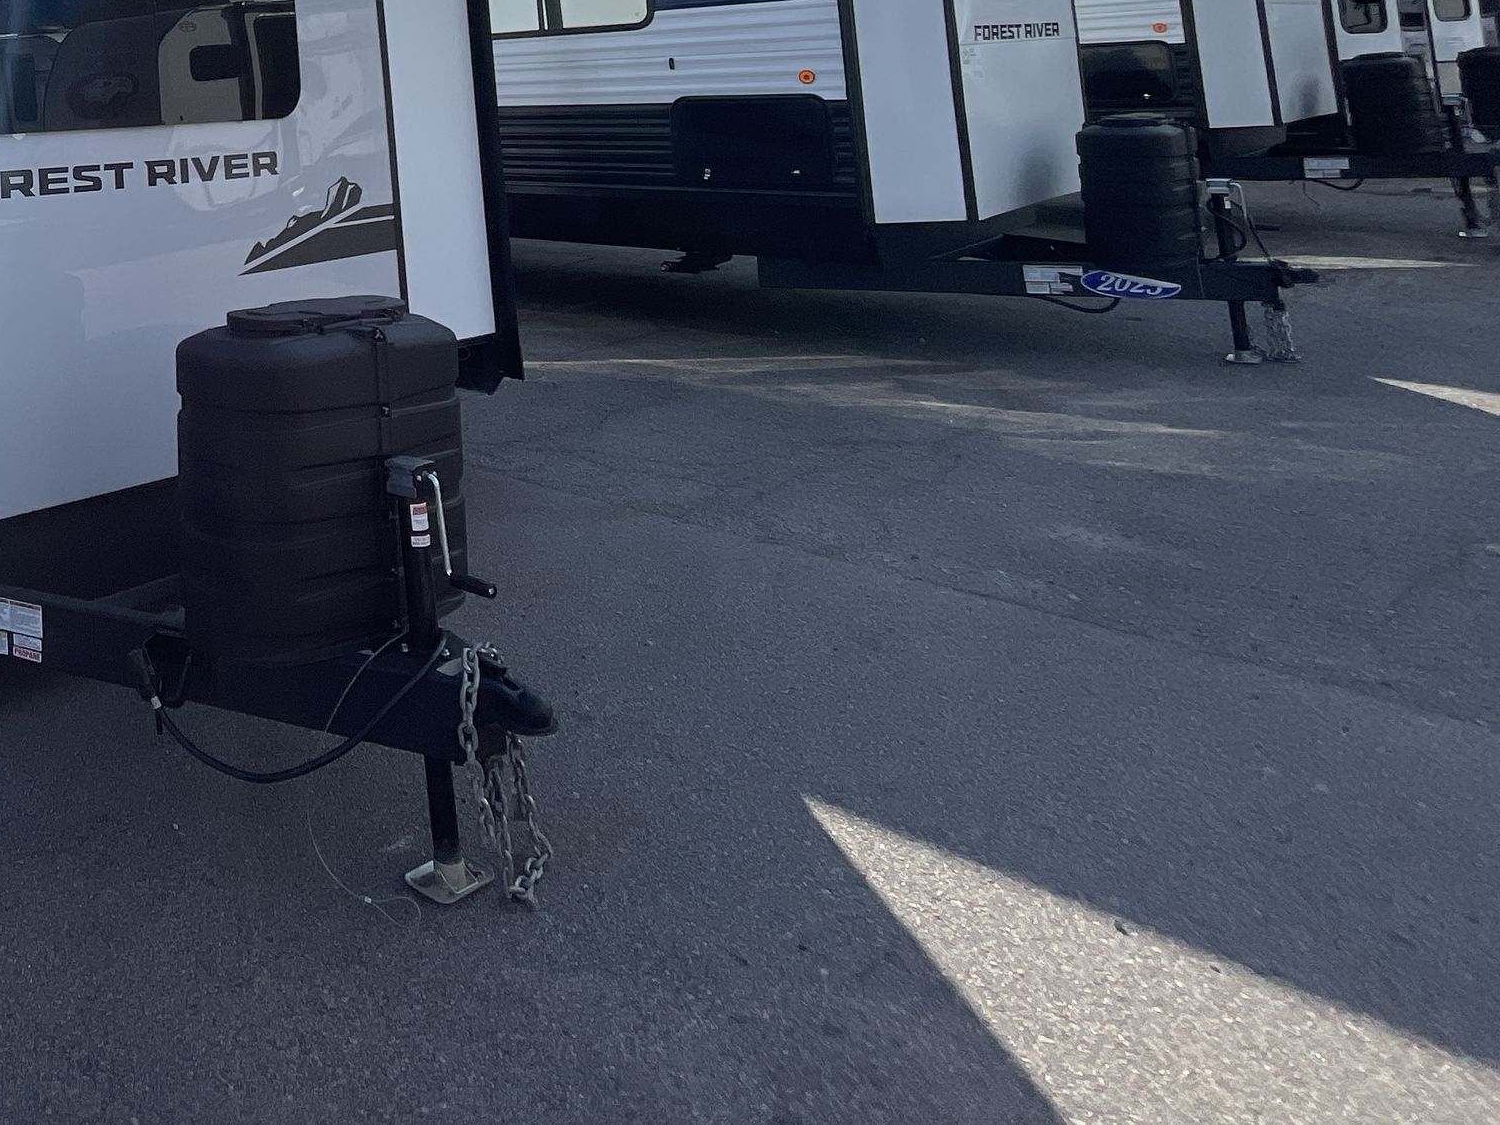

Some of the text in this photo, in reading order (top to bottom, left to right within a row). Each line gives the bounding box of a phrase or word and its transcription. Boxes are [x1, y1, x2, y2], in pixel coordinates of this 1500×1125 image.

[973, 22, 1060, 41] FOREST RIVER
[144, 150, 280, 187] RIVER
